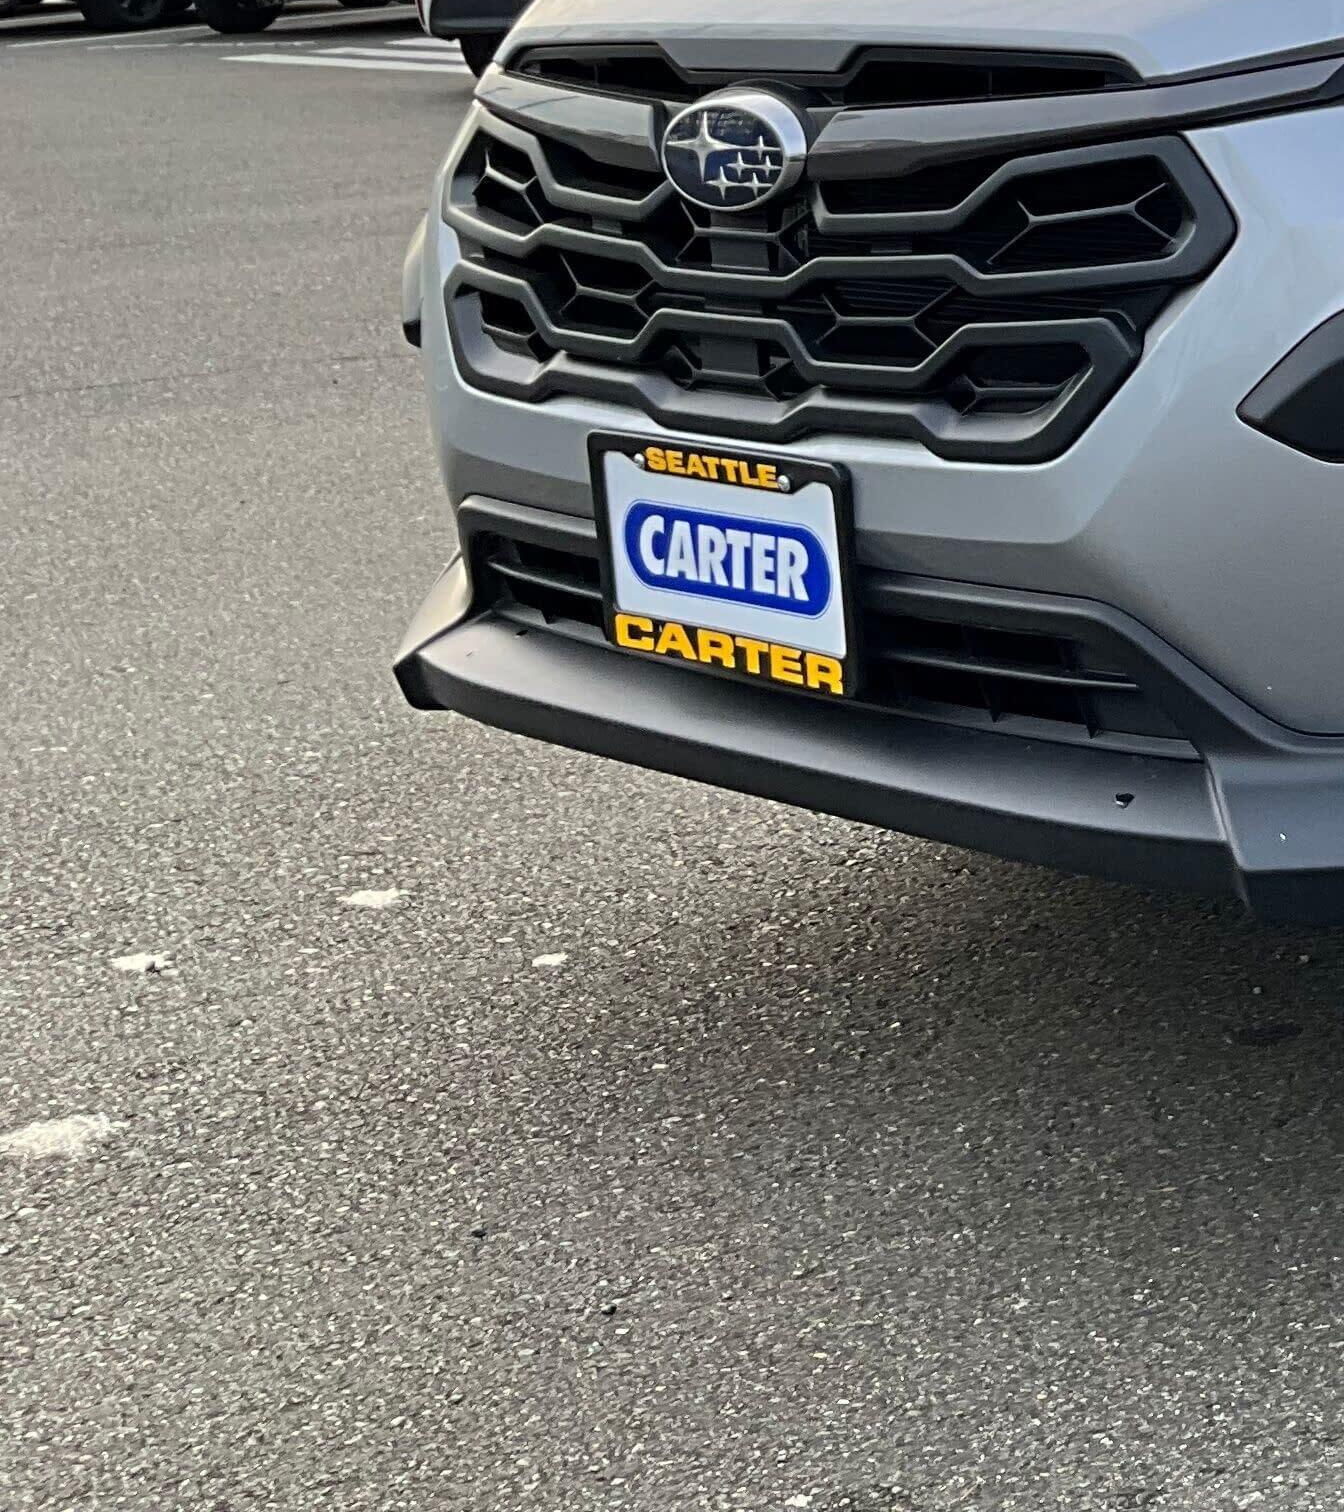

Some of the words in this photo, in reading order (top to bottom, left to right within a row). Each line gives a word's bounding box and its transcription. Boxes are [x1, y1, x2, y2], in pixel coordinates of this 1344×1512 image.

[645, 446, 780, 490] SEATTLE
[639, 514, 809, 602] CARTER
[614, 613, 843, 695] CARTER
